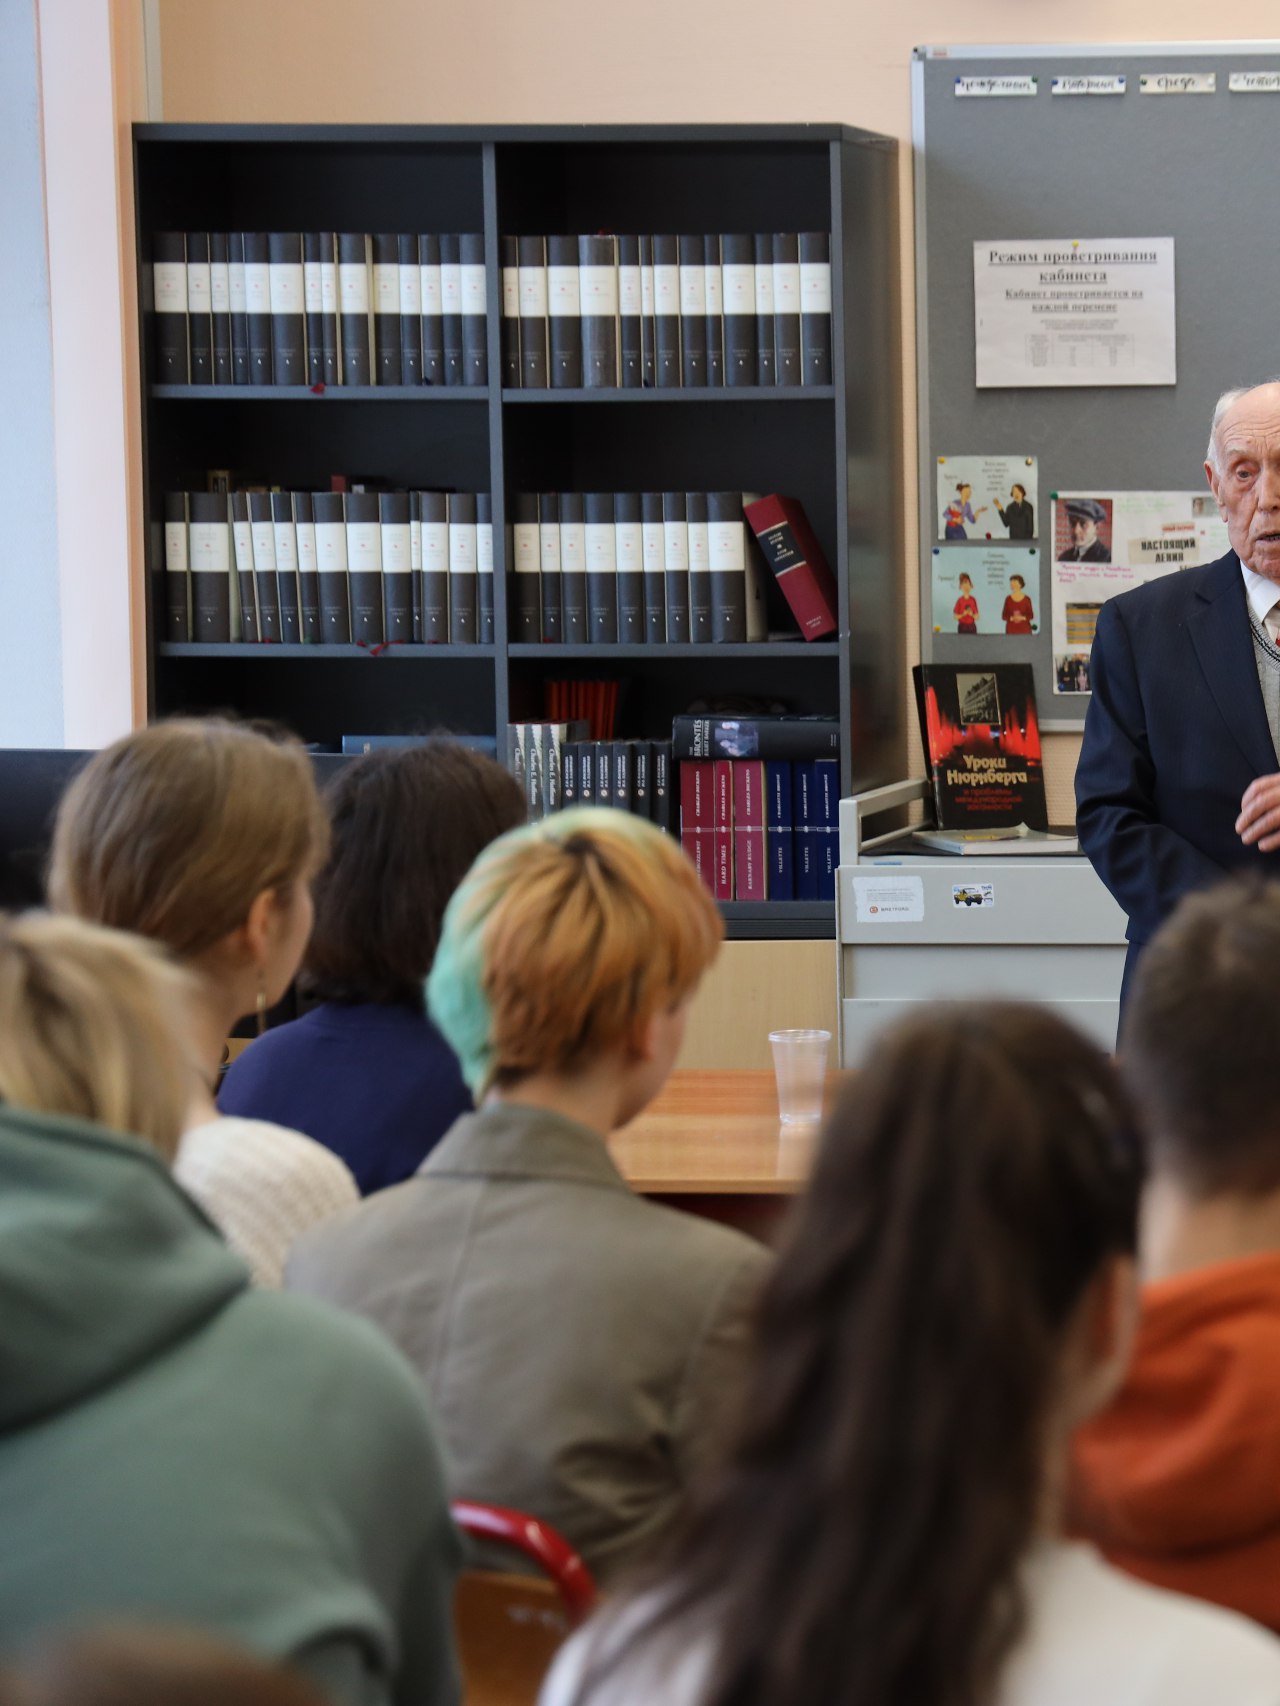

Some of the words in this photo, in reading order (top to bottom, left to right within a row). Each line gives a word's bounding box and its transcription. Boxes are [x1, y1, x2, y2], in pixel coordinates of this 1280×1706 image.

[989, 250, 1038, 264] Режим
[1043, 250, 1157, 265] проветривания
[1040, 268, 1107, 281] кабинета
[1005, 289, 1047, 299] Кабинет
[1050, 289, 1128, 300] проветривается
[1141, 538, 1196, 550] НАСТОЯЩИЙ
[1155, 552, 1184, 563] ЛЕНИН
[963, 754, 1007, 772] Уроки
[946, 768, 1028, 787] Нюрнберга
